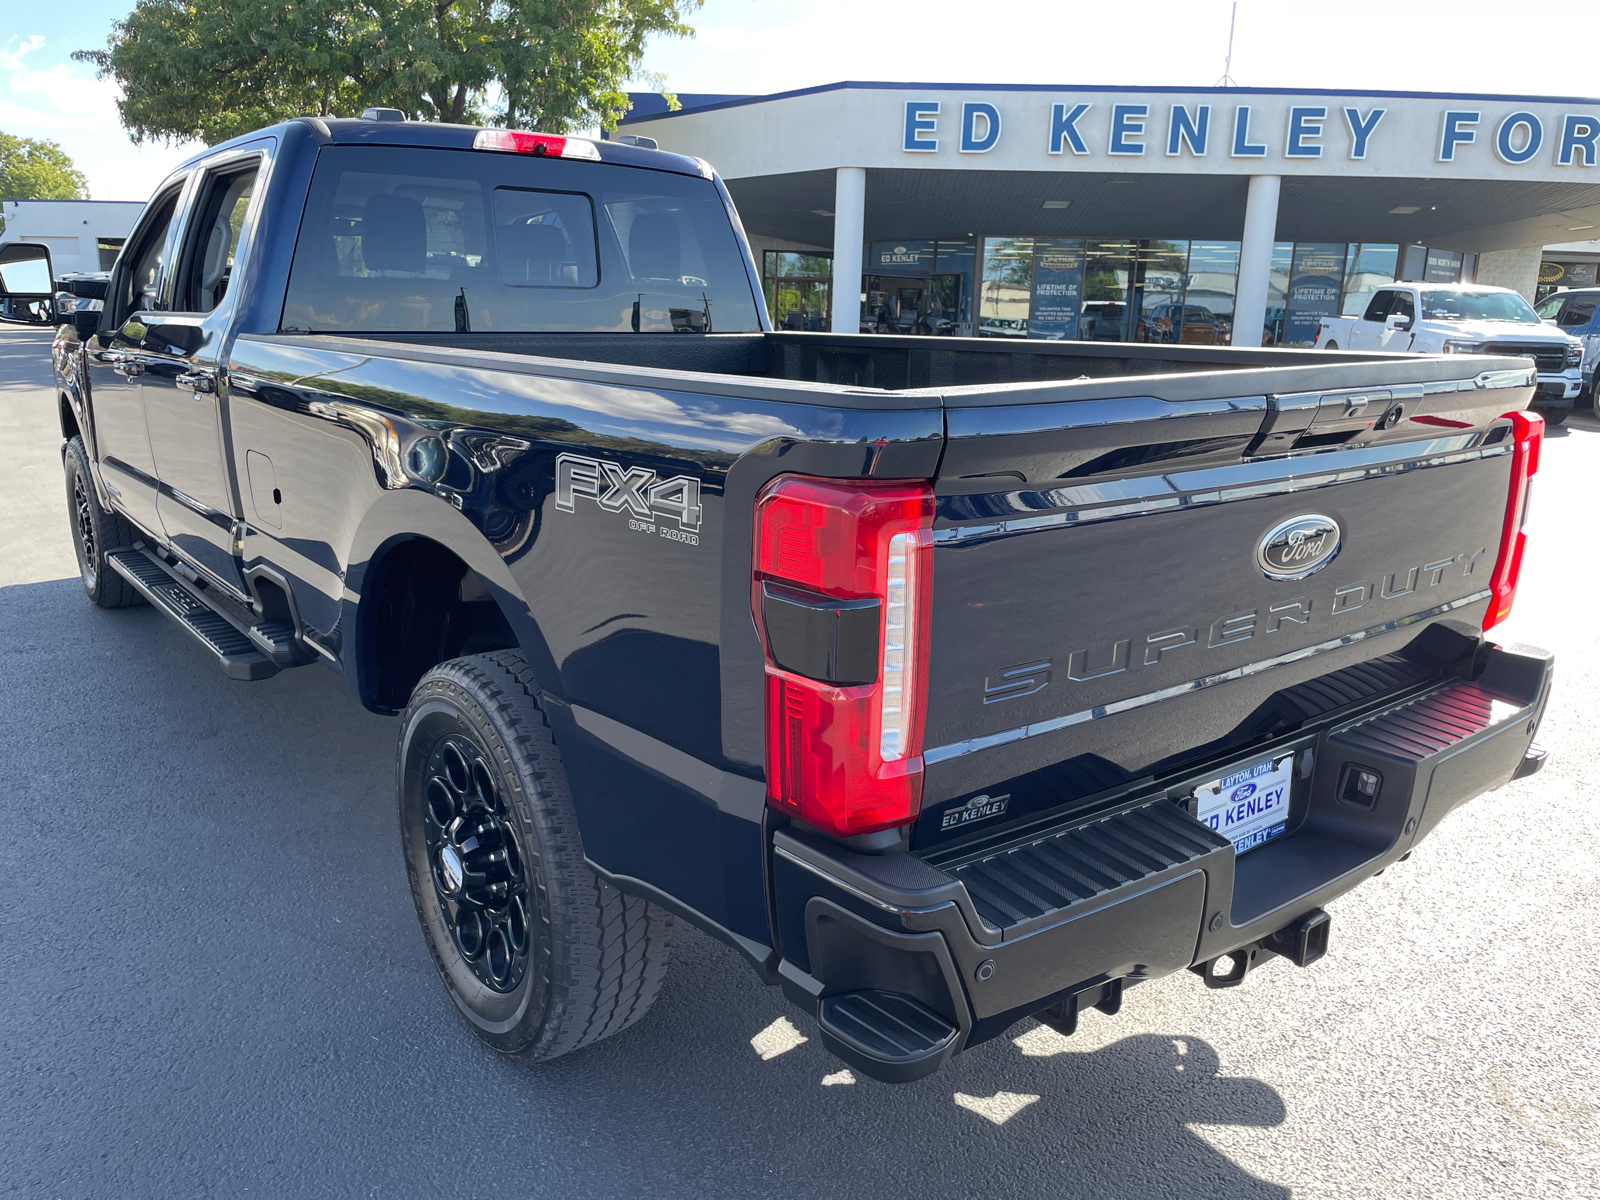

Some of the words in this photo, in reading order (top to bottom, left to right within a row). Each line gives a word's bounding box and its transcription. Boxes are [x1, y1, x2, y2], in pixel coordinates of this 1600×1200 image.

[902, 101, 1002, 155] ED
[1047, 102, 1388, 160] KENLEY
[1437, 109, 1600, 167] FOR
[892, 254, 919, 262] KENLEY
[555, 451, 703, 533] FX4
[628, 518, 656, 534] OFF
[659, 526, 699, 546] ROAD
[1281, 528, 1327, 563] Ford
[983, 596, 1313, 705] SUPER
[1332, 546, 1486, 617] DUTY
[1221, 770, 1252, 789] LAYTON,
[1253, 761, 1272, 777] UTAH
[942, 813, 959, 827] ED
[962, 800, 1008, 822] KENLEY
[1225, 787, 1284, 826] KENLEY
